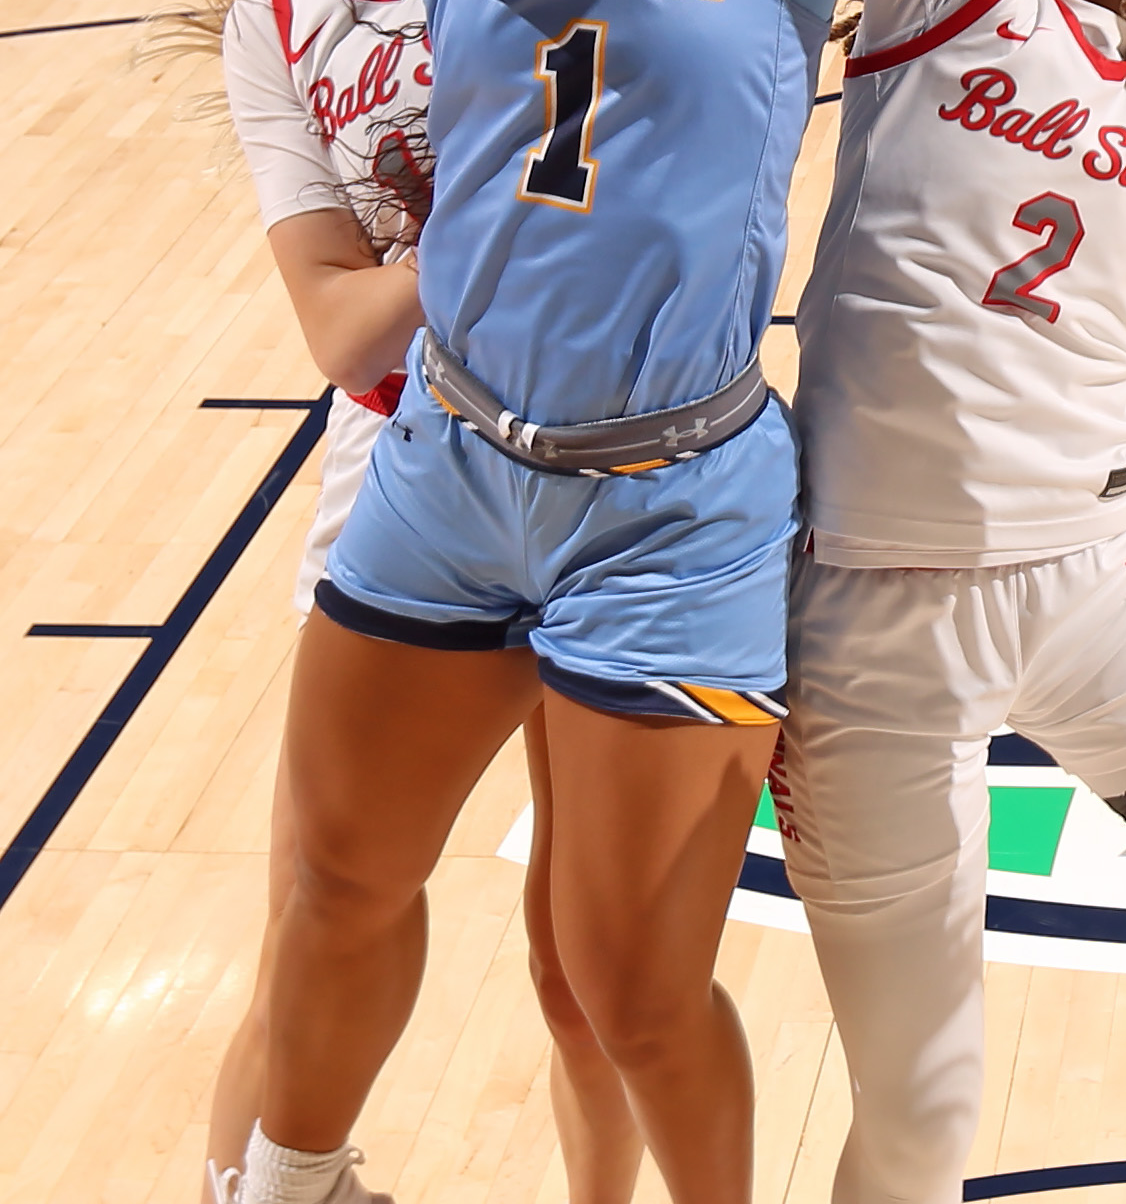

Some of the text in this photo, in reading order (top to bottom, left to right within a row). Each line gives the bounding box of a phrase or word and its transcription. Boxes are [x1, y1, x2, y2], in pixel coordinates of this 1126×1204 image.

[308, 34, 403, 147] Ball
[516, 18, 609, 215] 1
[938, 67, 1090, 160] Ball
[981, 191, 1085, 324] 2
